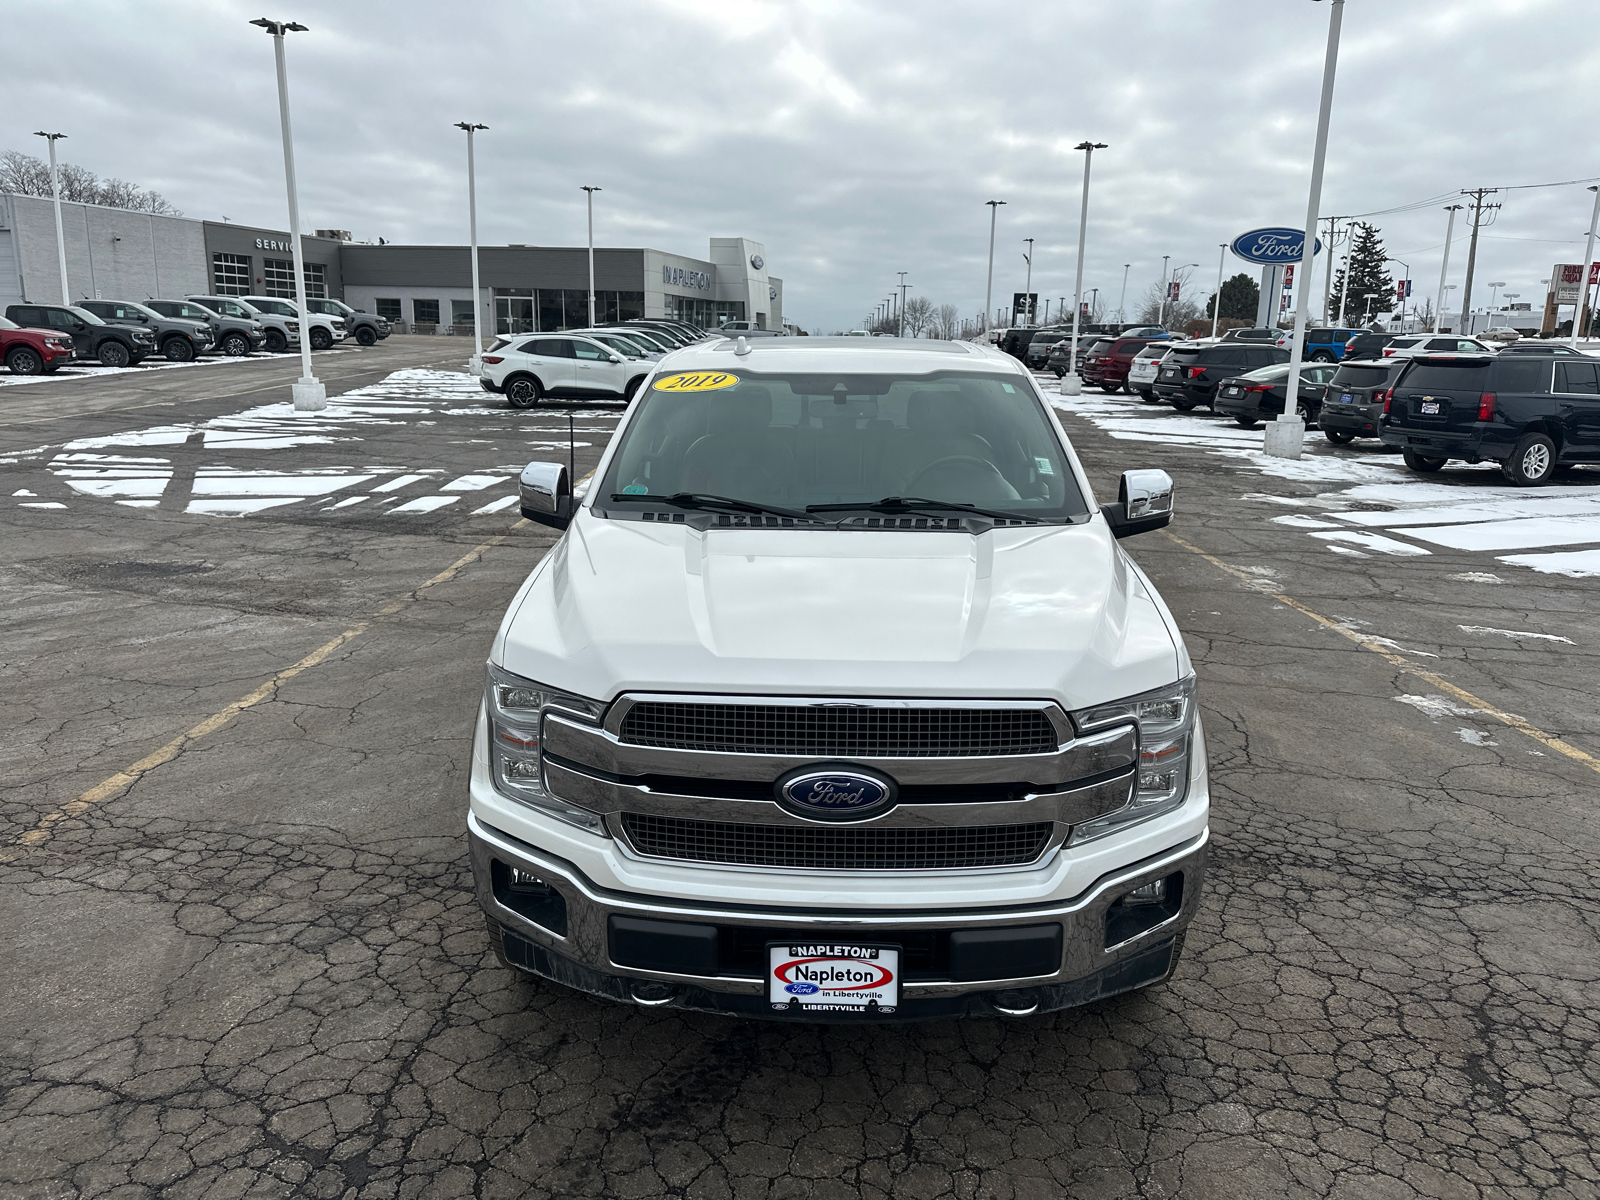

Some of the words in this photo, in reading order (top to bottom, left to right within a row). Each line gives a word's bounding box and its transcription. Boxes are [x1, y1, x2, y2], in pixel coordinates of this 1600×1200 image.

[255, 238, 294, 252] SERVIC
[1252, 234, 1304, 256] Ford
[663, 265, 711, 290] NAPLETON
[664, 374, 728, 389] 2019
[807, 780, 865, 805] Ford
[797, 945, 872, 959] NAPLETON
[795, 965, 874, 985] Napleton
[791, 983, 813, 994] Ford
[822, 990, 831, 998] in
[833, 990, 883, 999] Libertyville
[802, 1004, 866, 1012] LIBERTYVILLE
